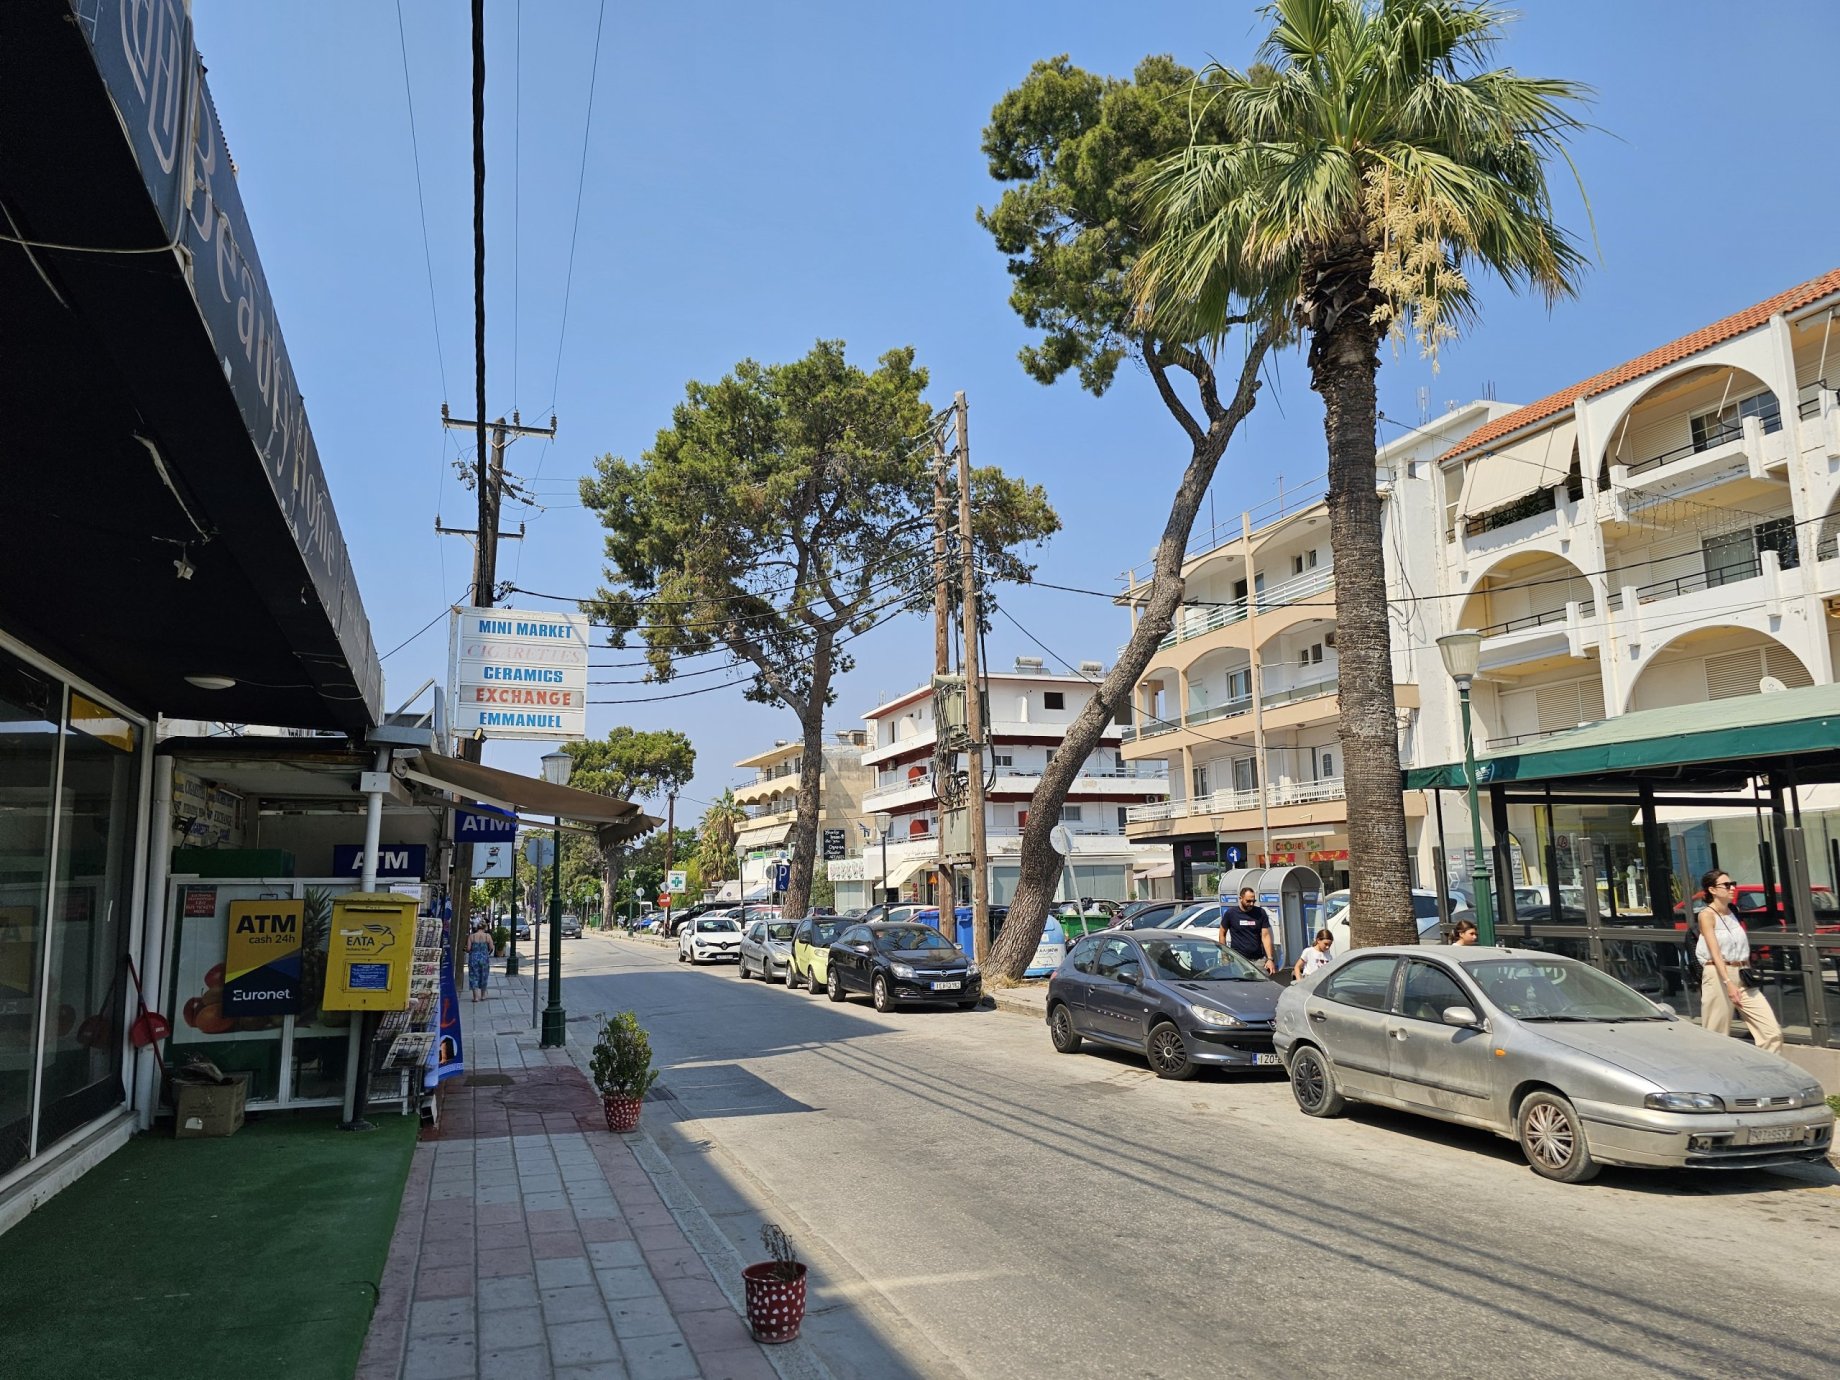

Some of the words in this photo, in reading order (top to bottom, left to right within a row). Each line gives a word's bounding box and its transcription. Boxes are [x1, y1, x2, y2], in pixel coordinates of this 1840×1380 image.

[188, 76, 295, 477] Beauty
[478, 619, 512, 635] MINI
[516, 622, 572, 639] MARKET
[483, 666, 563, 683] CERAMICS
[476, 687, 571, 706] EXCHANGE
[479, 711, 562, 728] EMMANUEL
[461, 815, 510, 832] ATM
[778, 865, 788, 882] P
[236, 914, 296, 934] ATM
[248, 935, 272, 944] cash
[275, 934, 295, 944] 24h
[232, 988, 290, 1001] Euronet
